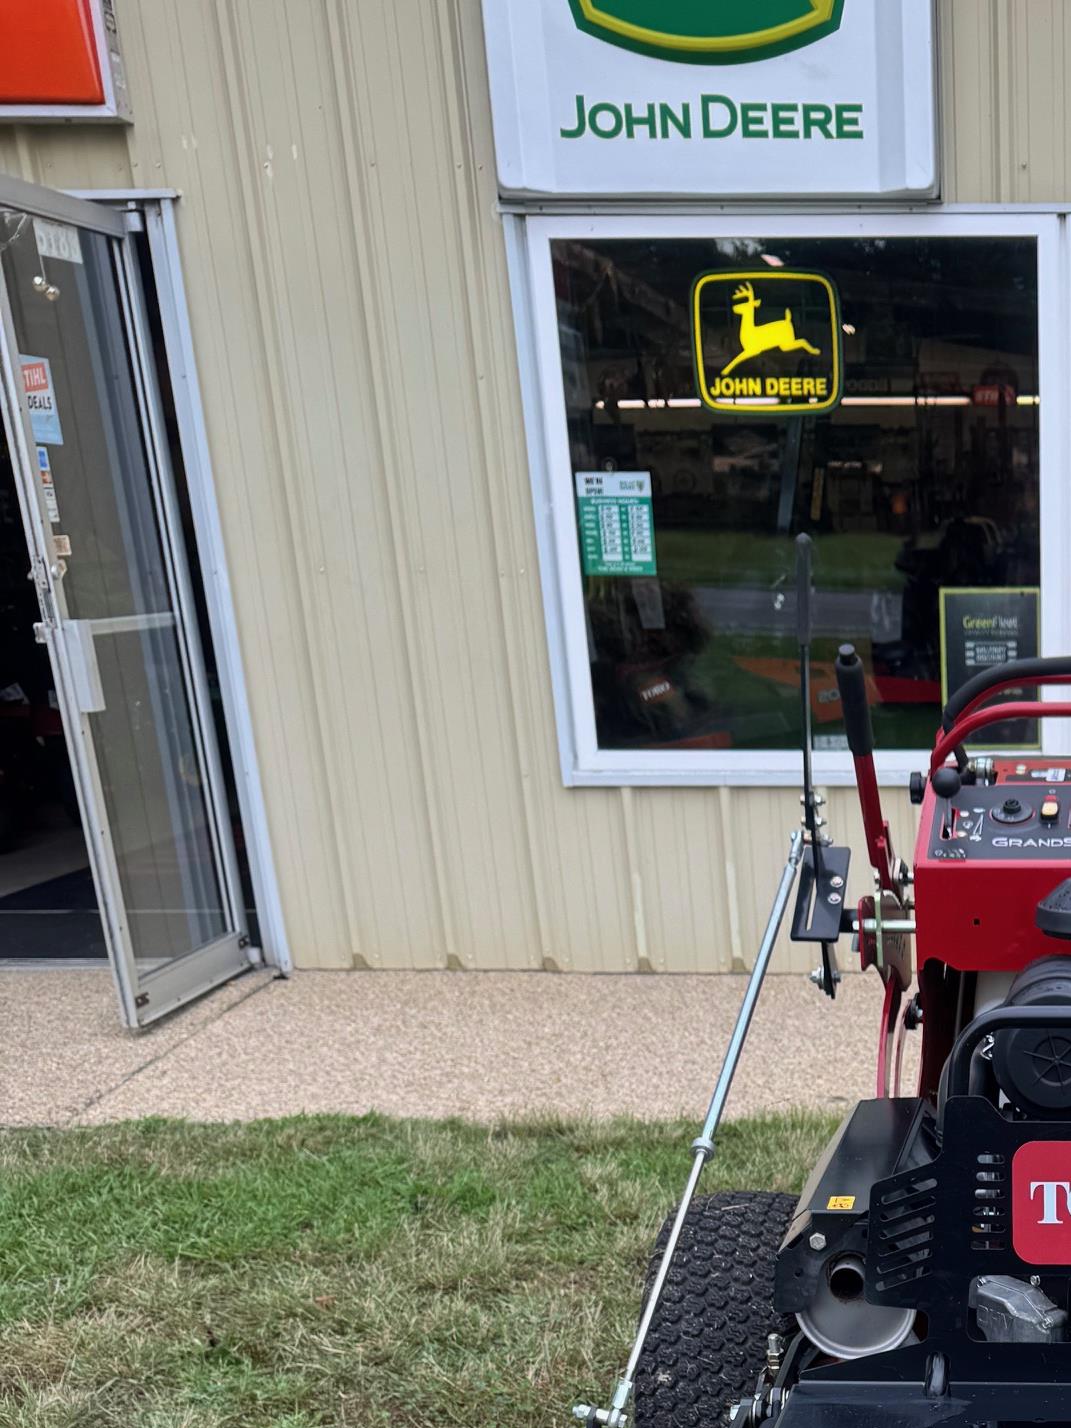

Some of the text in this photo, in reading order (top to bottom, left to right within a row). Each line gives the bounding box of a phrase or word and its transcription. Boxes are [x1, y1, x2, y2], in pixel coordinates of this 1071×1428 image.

[560, 94, 864, 140] JOHN DEERE
[709, 377, 762, 397] JOHN
[765, 377, 828, 397] DEERE
[28, 395, 52, 410] DEALS
